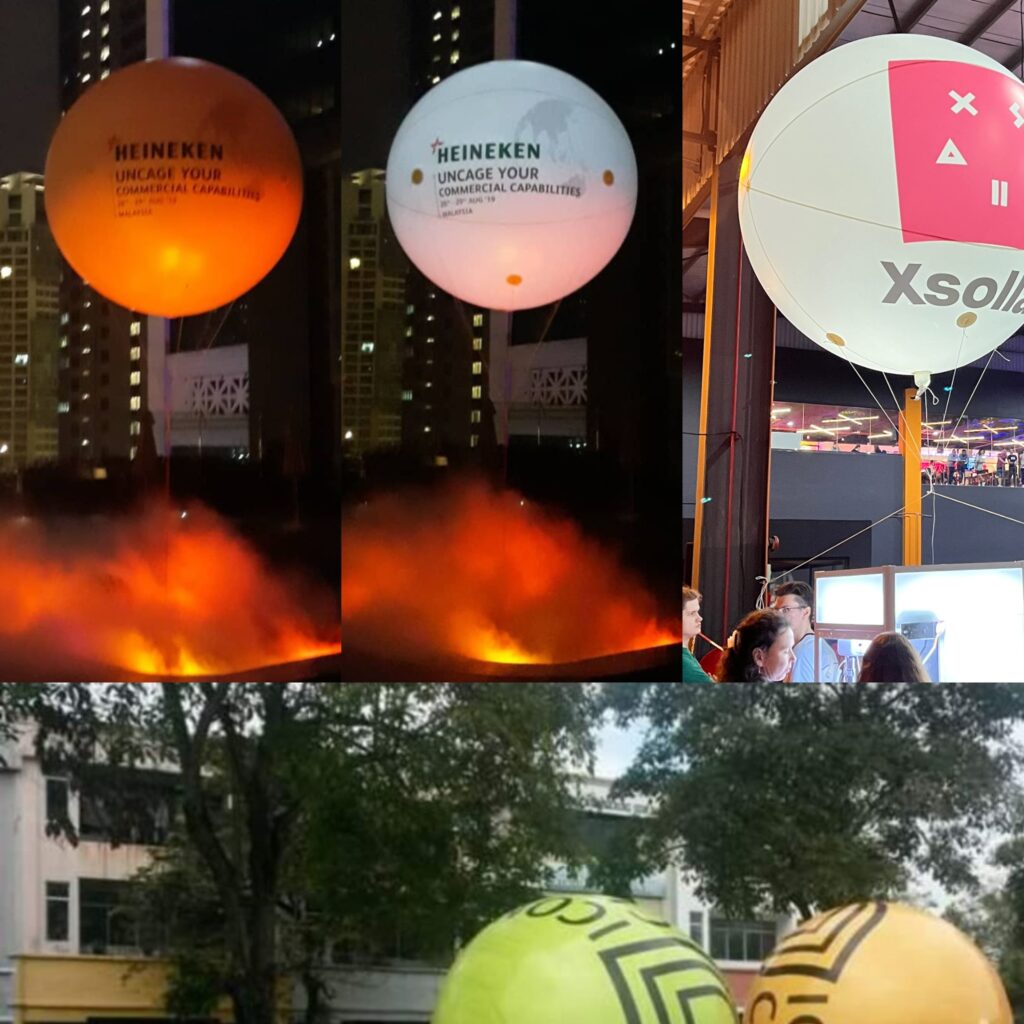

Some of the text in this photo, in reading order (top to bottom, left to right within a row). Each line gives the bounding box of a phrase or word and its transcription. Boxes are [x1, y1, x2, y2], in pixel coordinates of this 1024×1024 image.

[115, 142, 224, 161] HEINEKEN
[438, 142, 540, 164] HEINEKEN
[115, 167, 222, 182] UNCAGE YOUR
[438, 166, 539, 184] UNCAGE YOUR
[116, 183, 261, 202] COMMERCIAL CAPABILITIES
[439, 183, 581, 198] COMMERCIAL CAPABILITIES
[442, 207, 473, 218] MALAYSIA
